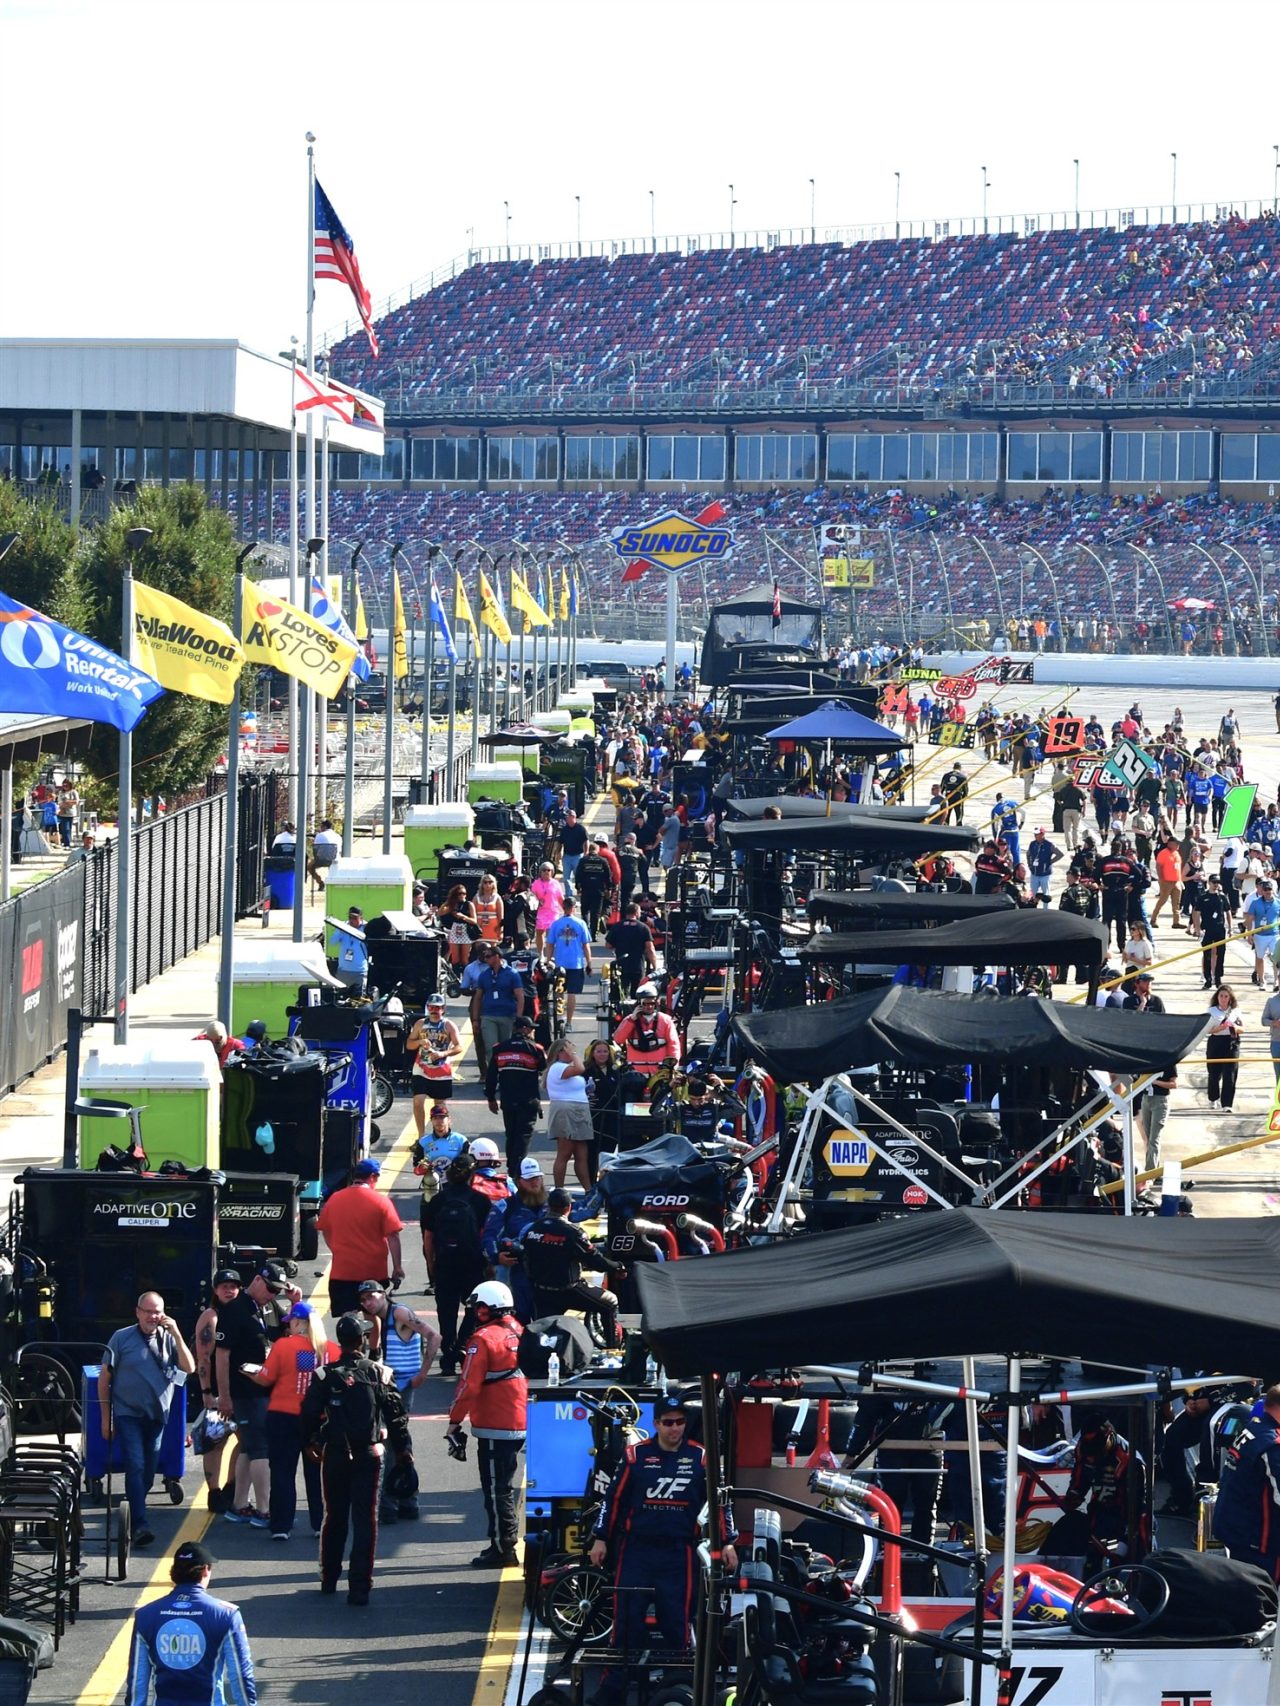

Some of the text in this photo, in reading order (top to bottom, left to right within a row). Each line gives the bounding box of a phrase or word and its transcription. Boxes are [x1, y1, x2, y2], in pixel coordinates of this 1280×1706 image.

[622, 532, 733, 553] SUNOCO
[164, 644, 202, 663] Treated
[204, 655, 230, 672] Pine
[1007, 664, 1028, 680] 71
[66, 681, 93, 694] Work
[1053, 721, 1080, 747] 19
[1112, 741, 1148, 788] 2
[1217, 784, 1259, 839] 1
[831, 1142, 868, 1164] NAPA
[641, 1195, 690, 1207] FORD
[906, 1190, 924, 1198] NGK
[93, 1201, 197, 1218] ADAPTIVE one
[231, 1209, 282, 1218] RACING
[127, 1218, 160, 1226] CALIPER
[611, 1235, 636, 1252] 66
[645, 1477, 692, 1500] J.F.
[642, 1504, 685, 1512] ELECTRIC
[160, 1633, 202, 1655] SODA
[164, 1654, 198, 1662] SENSE
